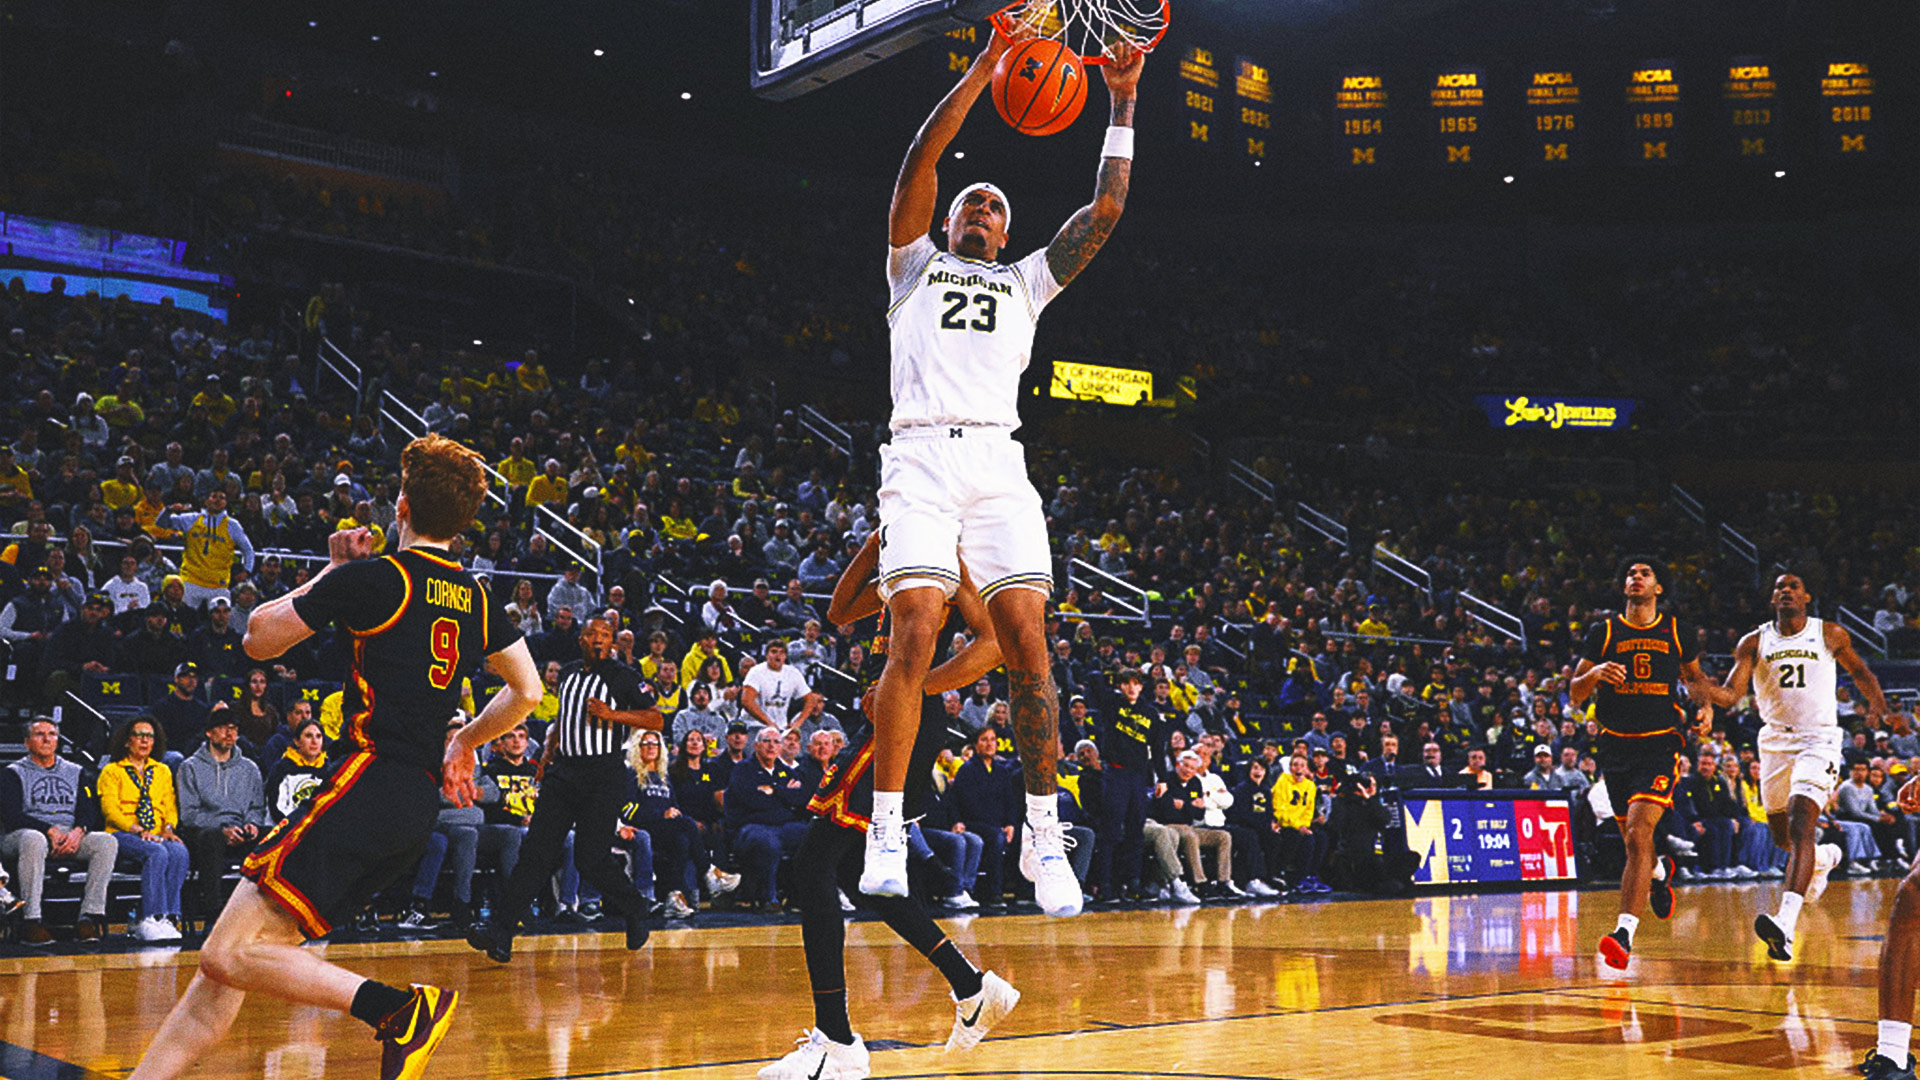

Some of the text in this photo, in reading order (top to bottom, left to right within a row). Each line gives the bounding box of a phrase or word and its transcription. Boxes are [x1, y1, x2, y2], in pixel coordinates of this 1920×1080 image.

[1632, 69, 1673, 83] NCAA
[1729, 66, 1770, 80] NCAA
[1828, 63, 1868, 76] NCAA
[1343, 76, 1382, 89] NCAA
[1437, 73, 1478, 88] NCAA
[1533, 72, 1573, 86] NCAA
[1186, 90, 1214, 113] 2021
[1536, 114, 1575, 131] 1976
[1636, 112, 1674, 129] 1989
[1832, 106, 1871, 123] 2018
[1190, 121, 1209, 142] M
[1344, 119, 1382, 135] 1964
[1440, 116, 1477, 133] 1965
[1247, 138, 1264, 157] M
[1545, 143, 1568, 160] M
[1644, 141, 1668, 159] M
[1841, 134, 1866, 152] M
[1352, 148, 1375, 164] M
[1448, 145, 1471, 162] M
[927, 270, 1013, 298] MICHIGAN
[941, 290, 998, 333] 23
[1090, 369, 1149, 385] MICHIGAN
[1081, 383, 1121, 394] UNION
[950, 428, 963, 438] M
[426, 577, 472, 614] CORNISH
[428, 616, 460, 690] 9
[1633, 652, 1651, 679] 6
[1778, 663, 1806, 689] 21
[101, 681, 121, 695] M
[302, 688, 319, 701] M
[31, 795, 74, 806] HAIL
[1451, 818, 1463, 840] 2
[1521, 817, 1533, 839] 0
[1478, 833, 1511, 849] 19:04
